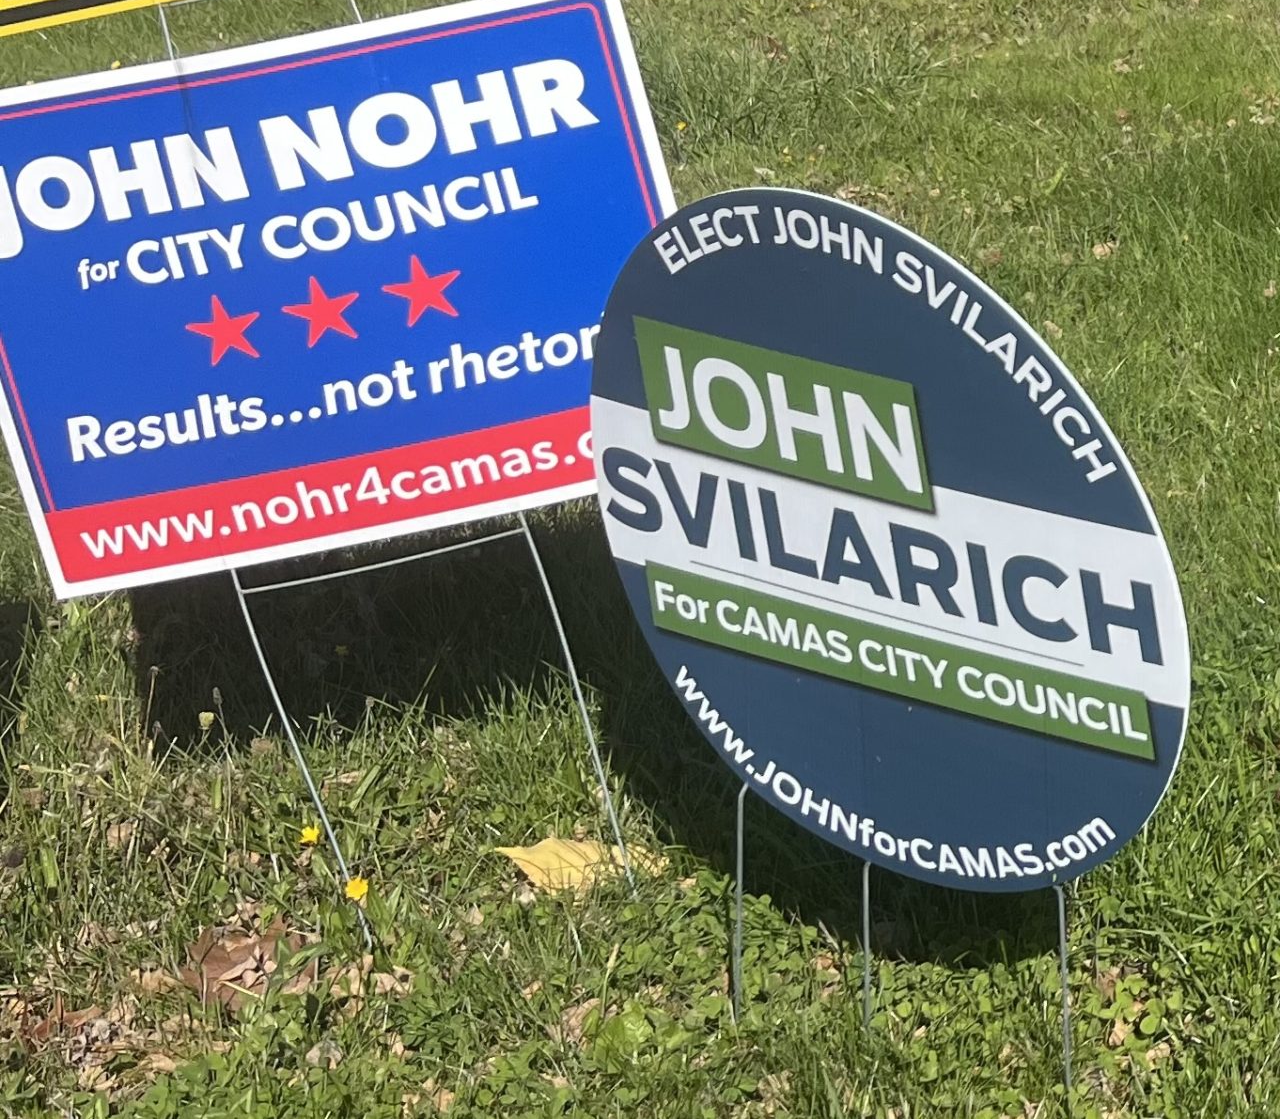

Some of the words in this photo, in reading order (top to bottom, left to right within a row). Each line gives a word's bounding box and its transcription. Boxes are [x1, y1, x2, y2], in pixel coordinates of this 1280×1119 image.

[259, 58, 599, 191] NOHR
[78, 258, 120, 290] for
[126, 223, 245, 285] CITY
[261, 168, 539, 261] COUNCIL
[429, 310, 605, 394] rhetor
[654, 205, 760, 276] ELECT
[774, 206, 884, 275] JOHN
[893, 251, 1118, 484] SVILARICH
[80, 431, 593, 559] www.nohr4camas.c
[657, 346, 925, 495] JOHN
[602, 447, 1163, 666] SVILARICH
[654, 582, 711, 624] For
[715, 600, 852, 665] CAMAS
[859, 638, 947, 688] CITY
[957, 667, 1149, 743] COUNCIL
[674, 665, 1117, 880] www.JOHNforCAMAS.com
